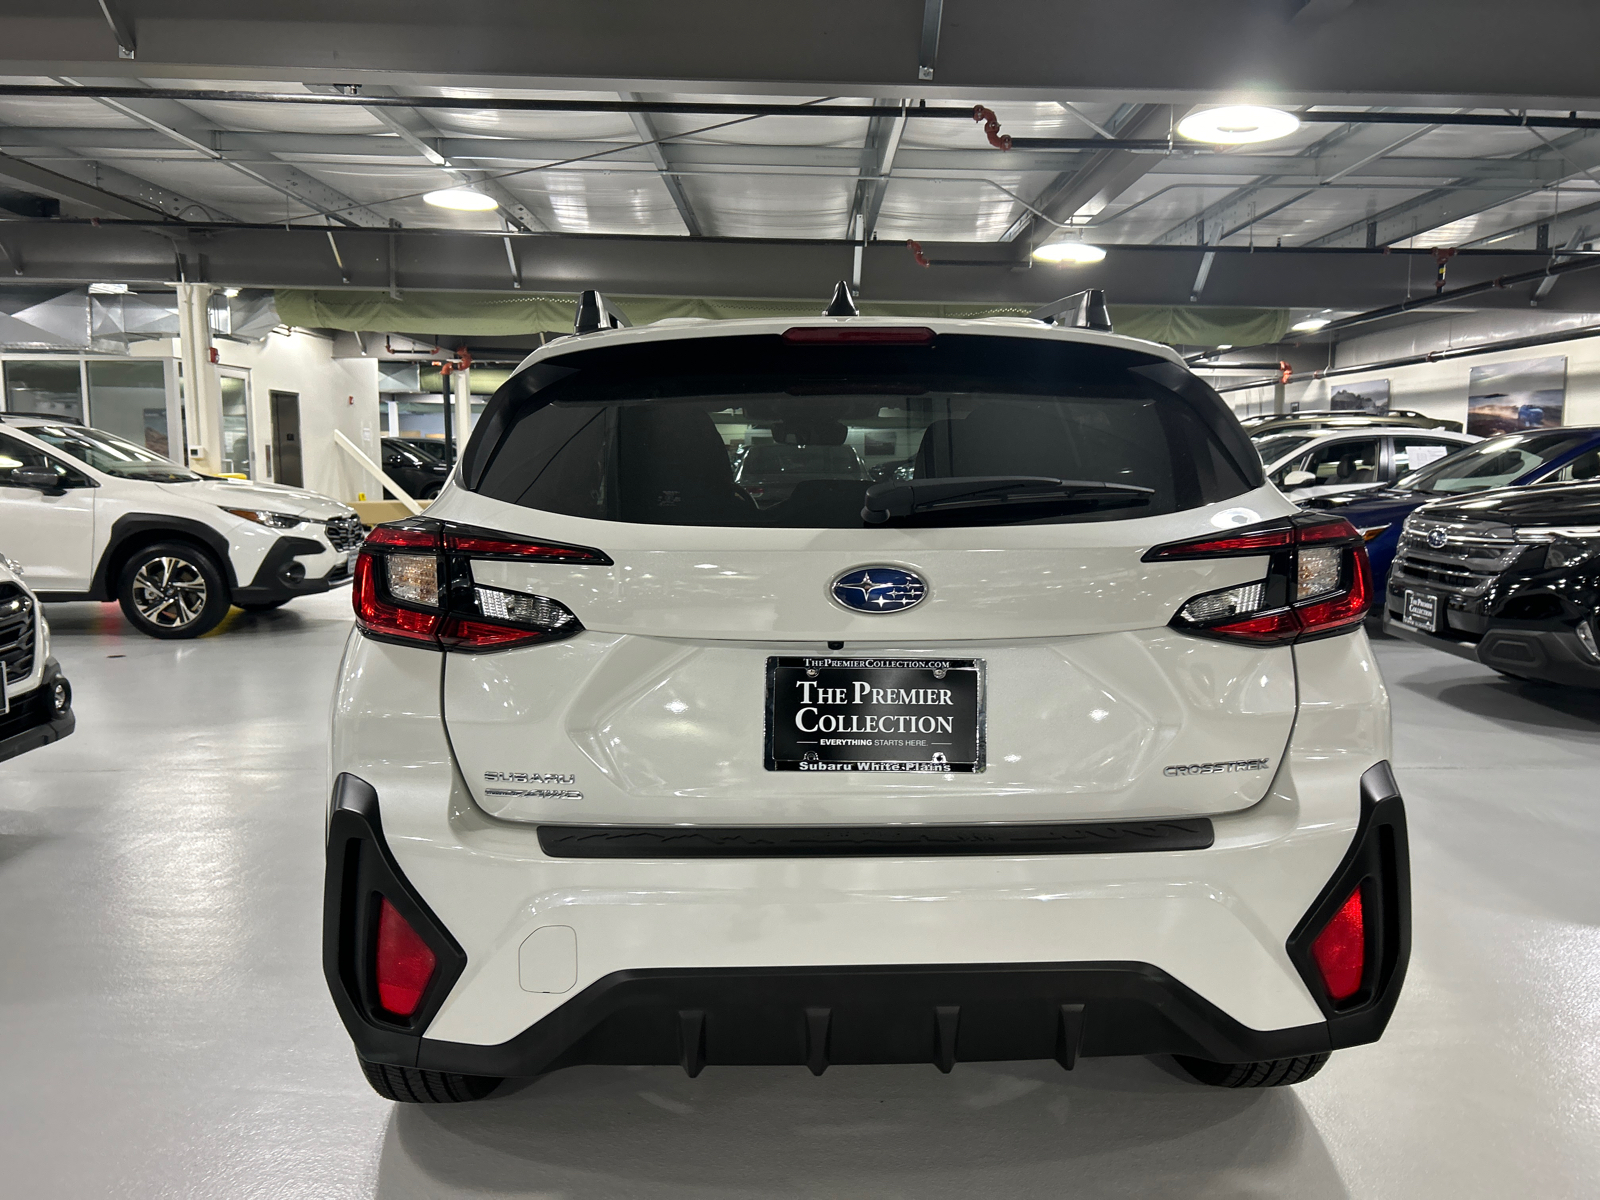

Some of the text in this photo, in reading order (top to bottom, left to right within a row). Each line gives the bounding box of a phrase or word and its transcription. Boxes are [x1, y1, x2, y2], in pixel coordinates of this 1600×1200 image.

[803, 658, 950, 669] THEPREMIERCOLLECTION.COM
[796, 680, 954, 706] THE PREMIER
[795, 707, 954, 733] COLLECTION
[820, 738, 928, 747] EVERYTHING STARTS HERE.
[799, 761, 951, 772] Subaru White Plains
[1163, 757, 1270, 777] CROSSTREK
[484, 771, 575, 785] SUBARU
